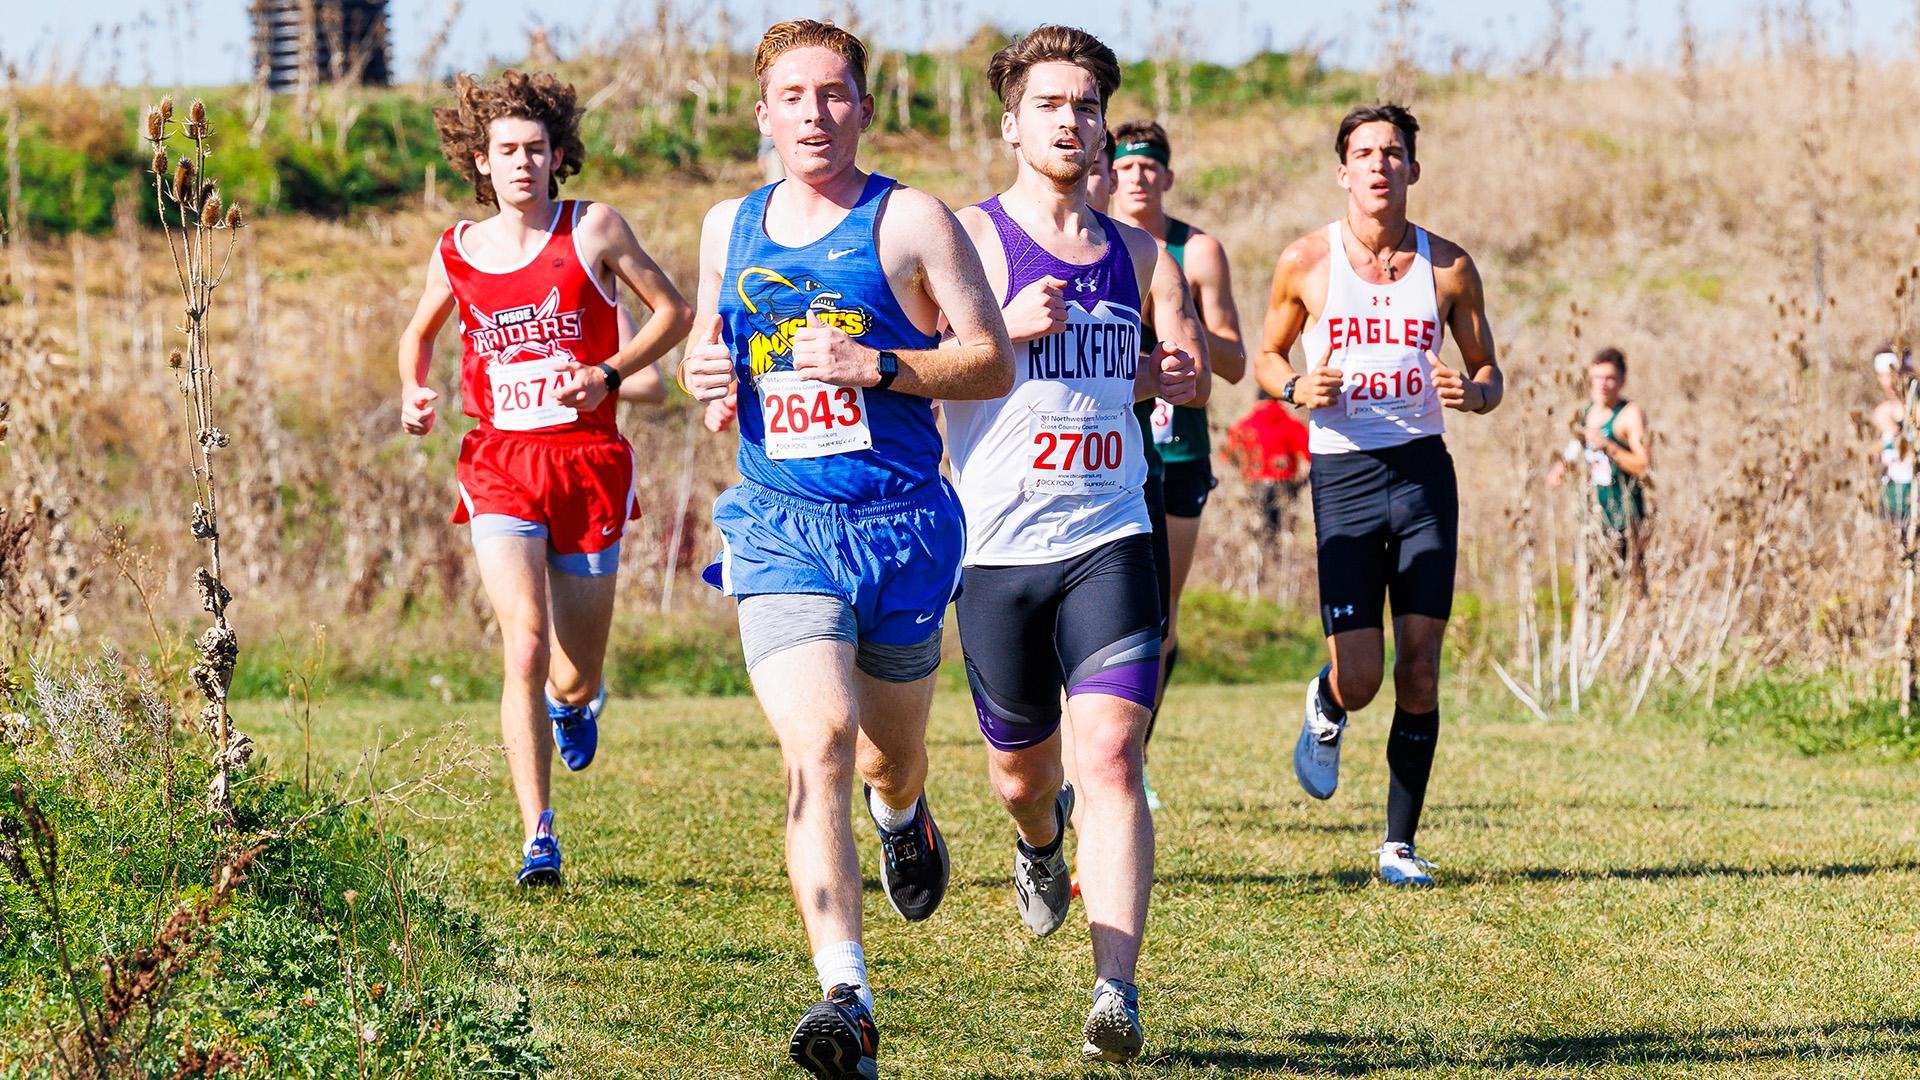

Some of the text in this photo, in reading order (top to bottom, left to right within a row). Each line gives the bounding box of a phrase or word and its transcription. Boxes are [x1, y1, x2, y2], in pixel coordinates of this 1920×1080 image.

[473, 314, 579, 352] RAIDERS
[498, 308, 533, 326] MSOE
[1328, 317, 1436, 352] EAGLES
[751, 312, 864, 375] MUSES
[1028, 322, 1137, 381] ROCKFORD
[1351, 367, 1423, 401] 2616
[765, 386, 862, 434] 2643
[1032, 430, 1123, 471] 2700
